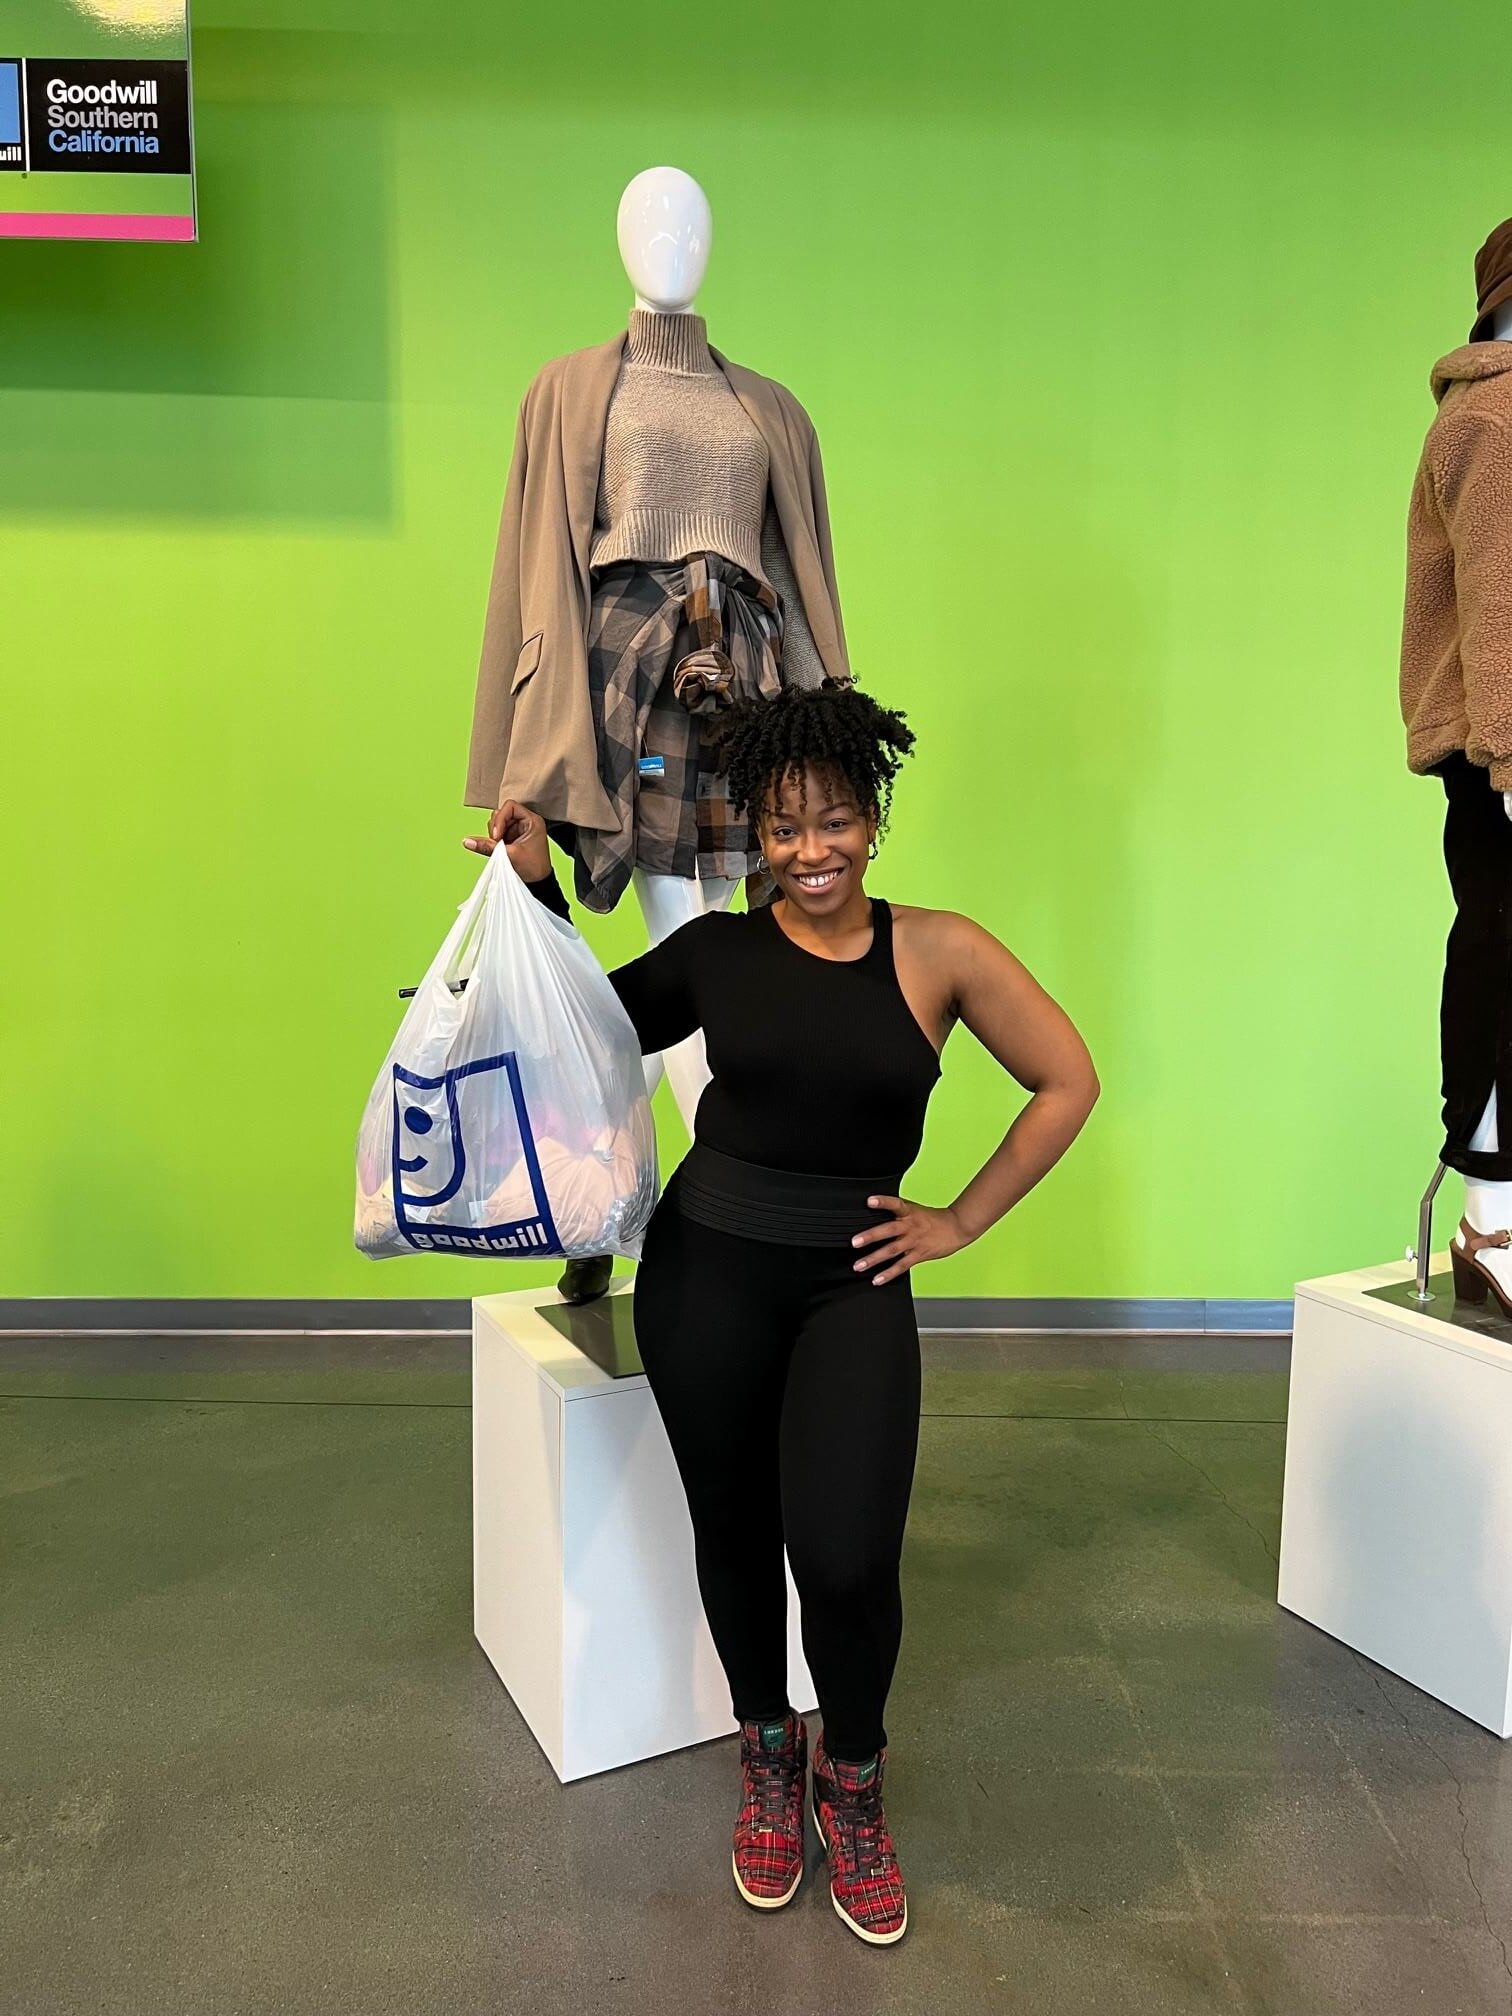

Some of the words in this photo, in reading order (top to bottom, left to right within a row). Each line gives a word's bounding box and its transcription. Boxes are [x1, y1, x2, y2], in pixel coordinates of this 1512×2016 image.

[46, 78, 158, 105] Goodwill
[48, 105, 158, 129] Southern
[48, 129, 159, 154] California
[411, 1223, 548, 1250] goodwill
